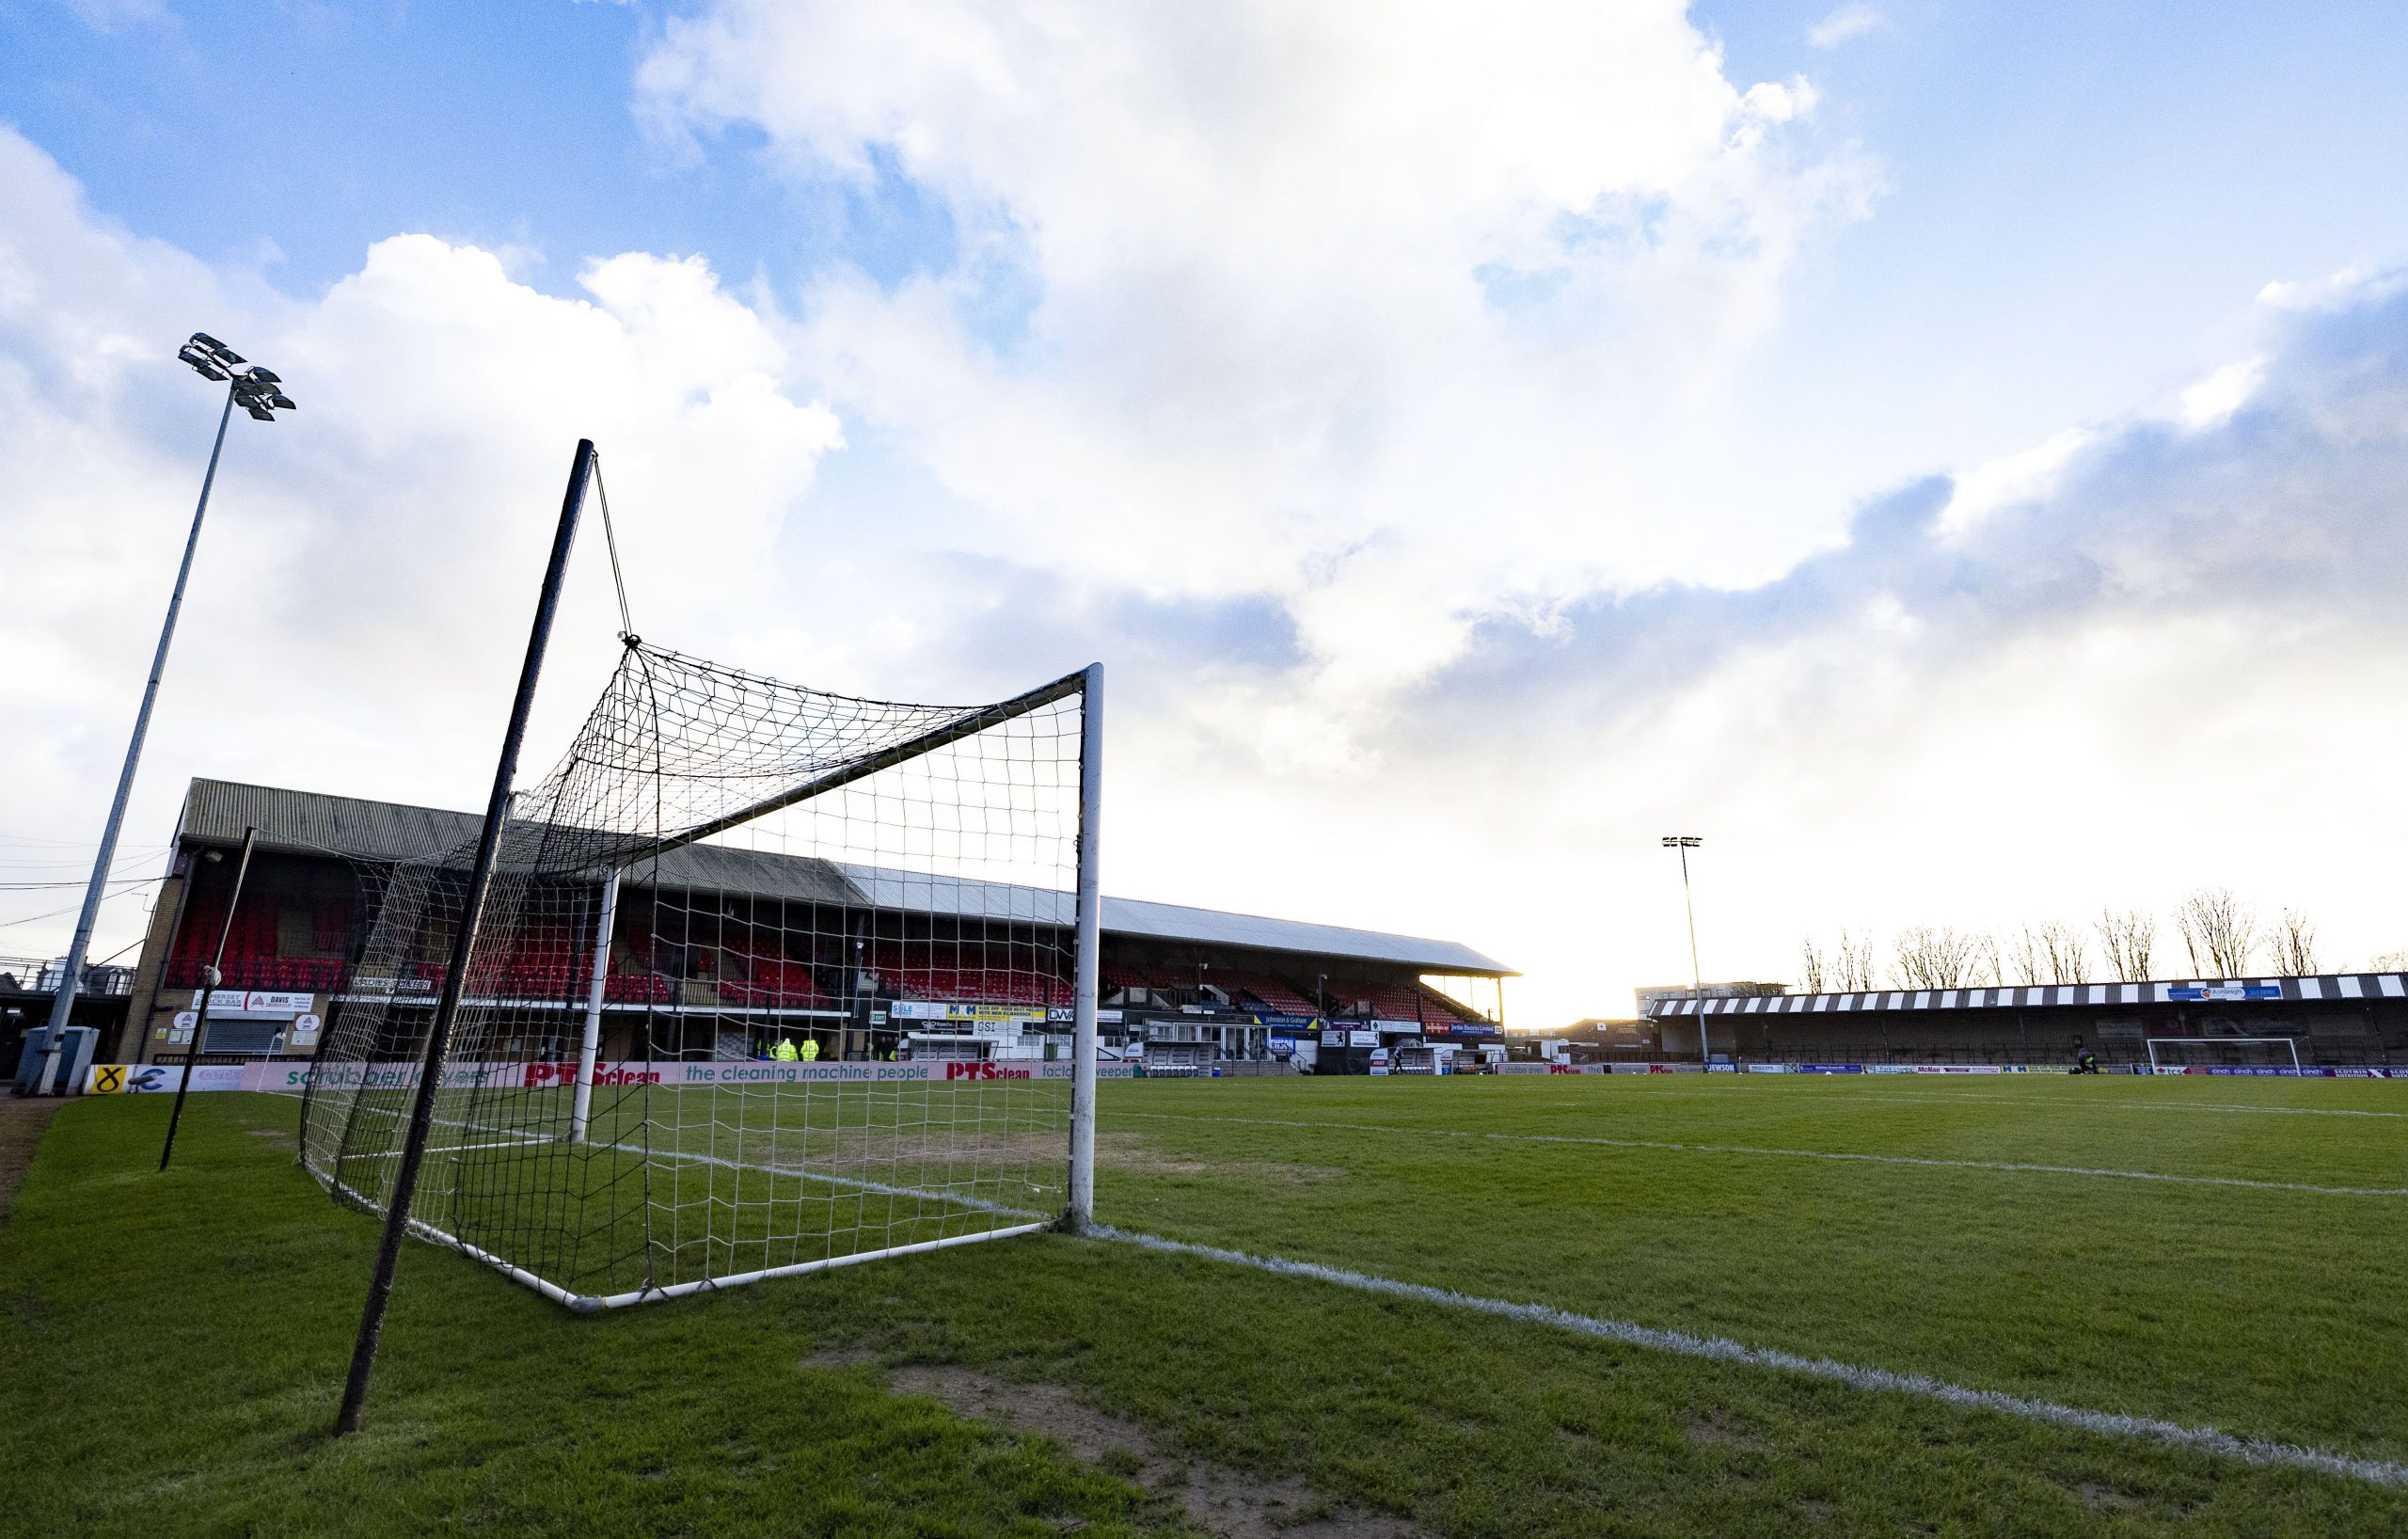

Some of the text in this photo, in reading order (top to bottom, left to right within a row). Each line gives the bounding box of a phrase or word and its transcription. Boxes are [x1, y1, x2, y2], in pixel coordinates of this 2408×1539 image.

[949, 1005, 976, 1016] MKM
[686, 1065, 928, 1082] the cleaning machine people
